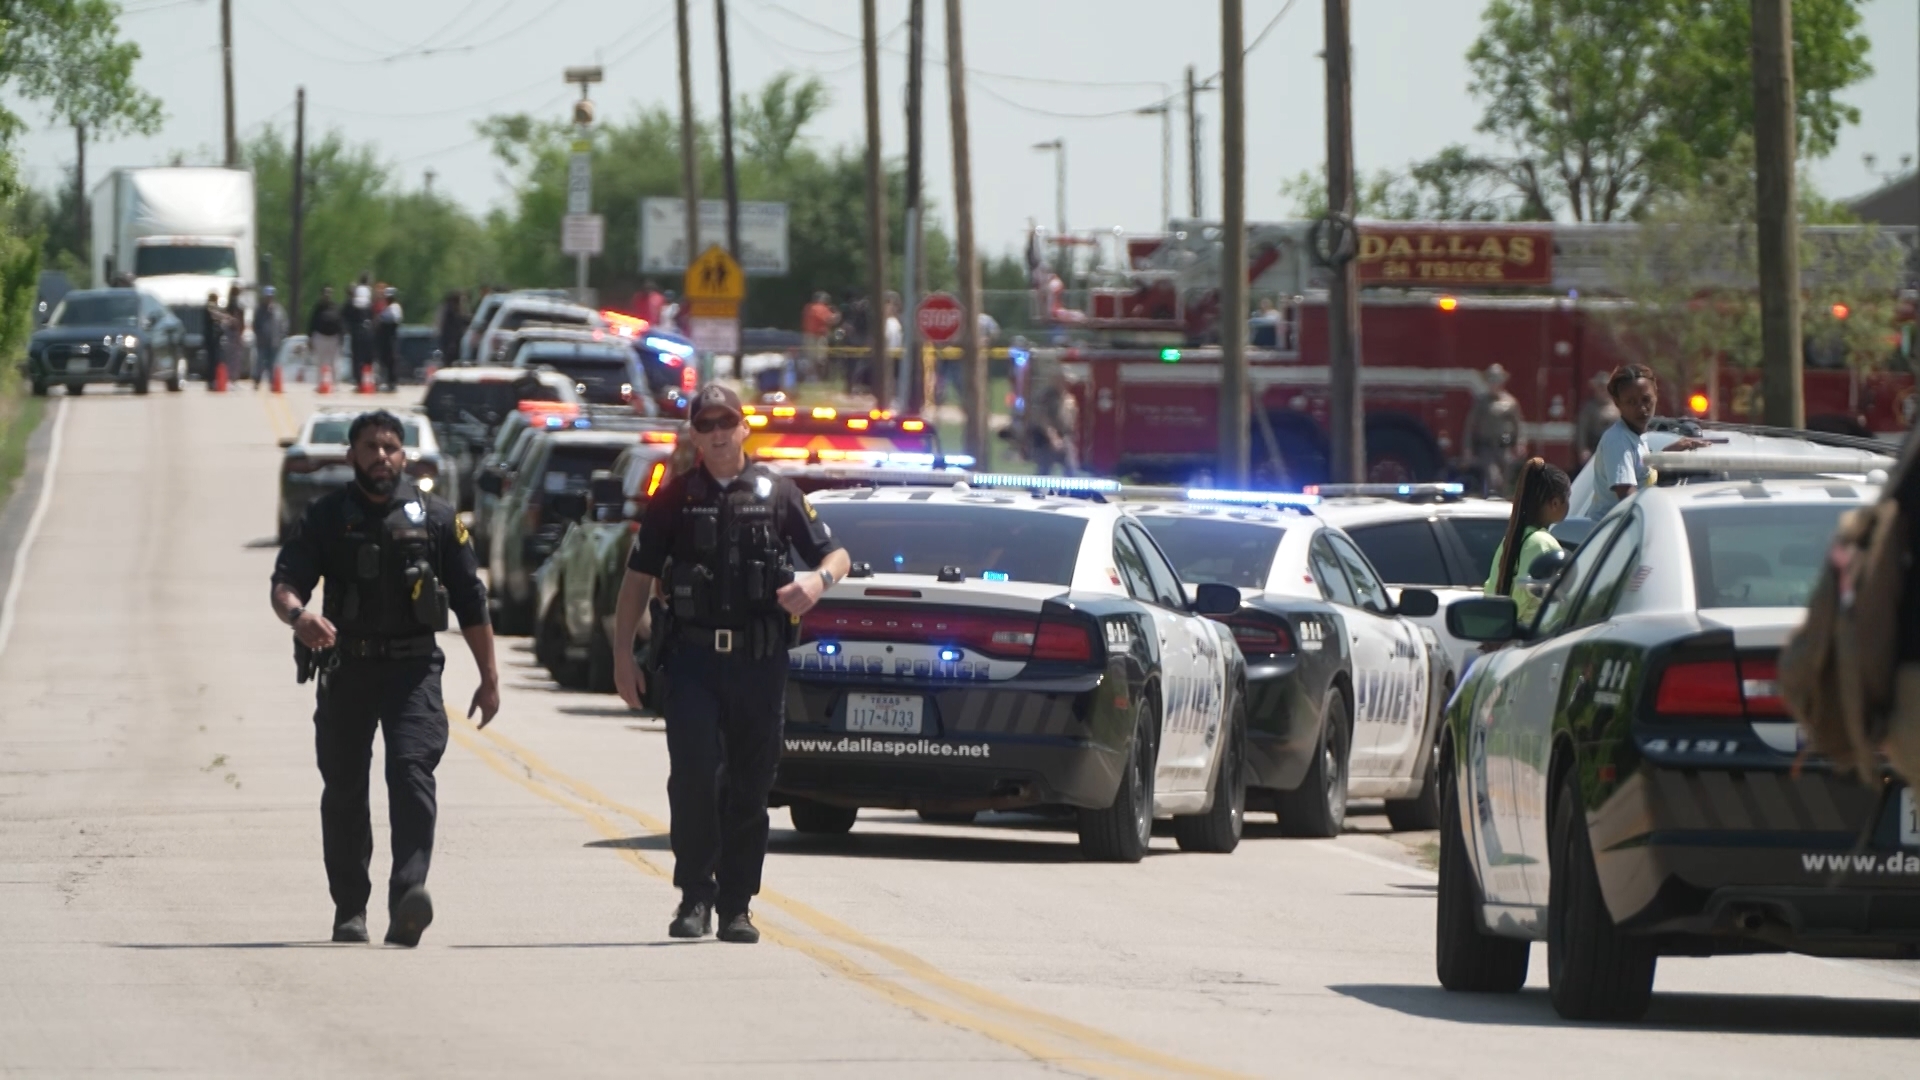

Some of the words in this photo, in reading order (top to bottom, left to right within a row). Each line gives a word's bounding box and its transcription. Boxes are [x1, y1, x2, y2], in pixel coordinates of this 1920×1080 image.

[1358, 234, 1536, 267] DALLAS
[1416, 261, 1504, 278] TRUCK
[918, 308, 961, 328] STOP
[894, 658, 990, 680] POLICE
[870, 696, 901, 706] TEXAS
[784, 737, 991, 757] www.dallaspolice.net
[1643, 738, 1739, 752] 4191
